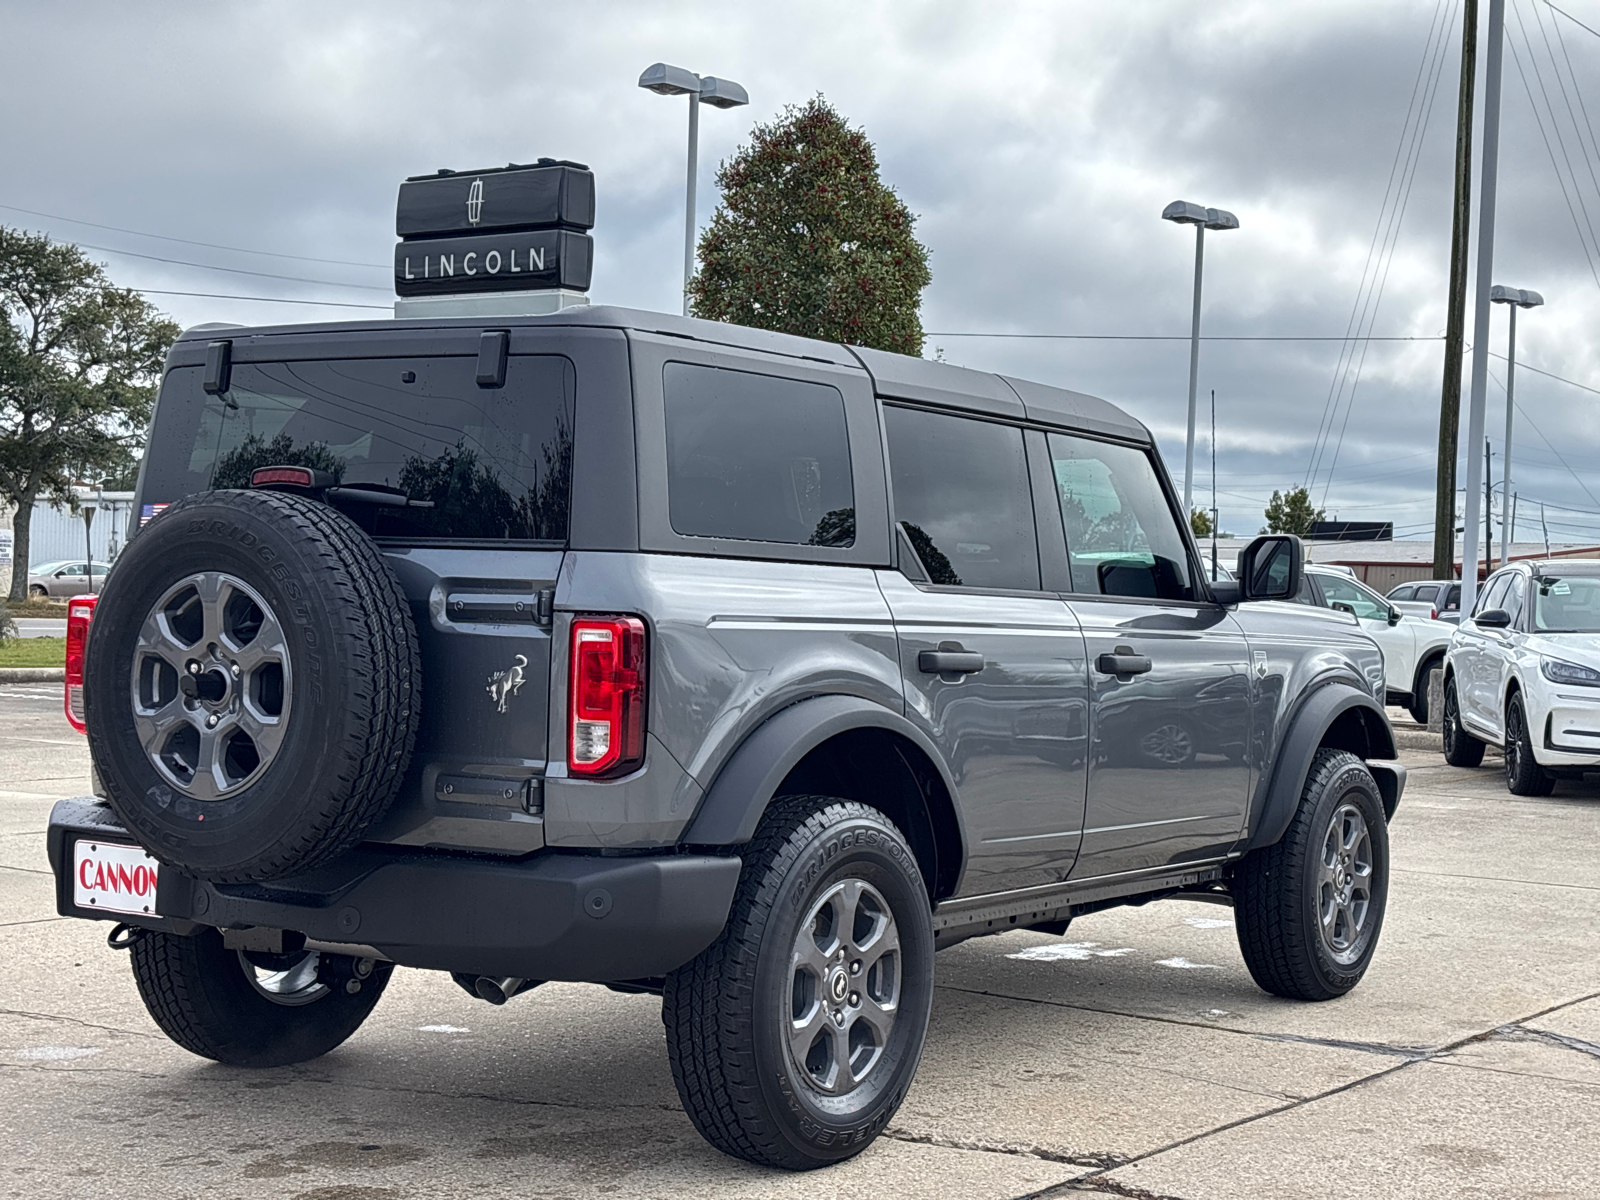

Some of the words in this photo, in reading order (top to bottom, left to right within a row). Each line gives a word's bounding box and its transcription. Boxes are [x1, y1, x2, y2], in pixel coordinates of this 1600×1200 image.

[404, 247, 545, 280] LINCOLN
[187, 518, 323, 706] BRIDGESTONE
[790, 828, 920, 912] BRIDGESTONE
[800, 1085, 902, 1147] DUELER
